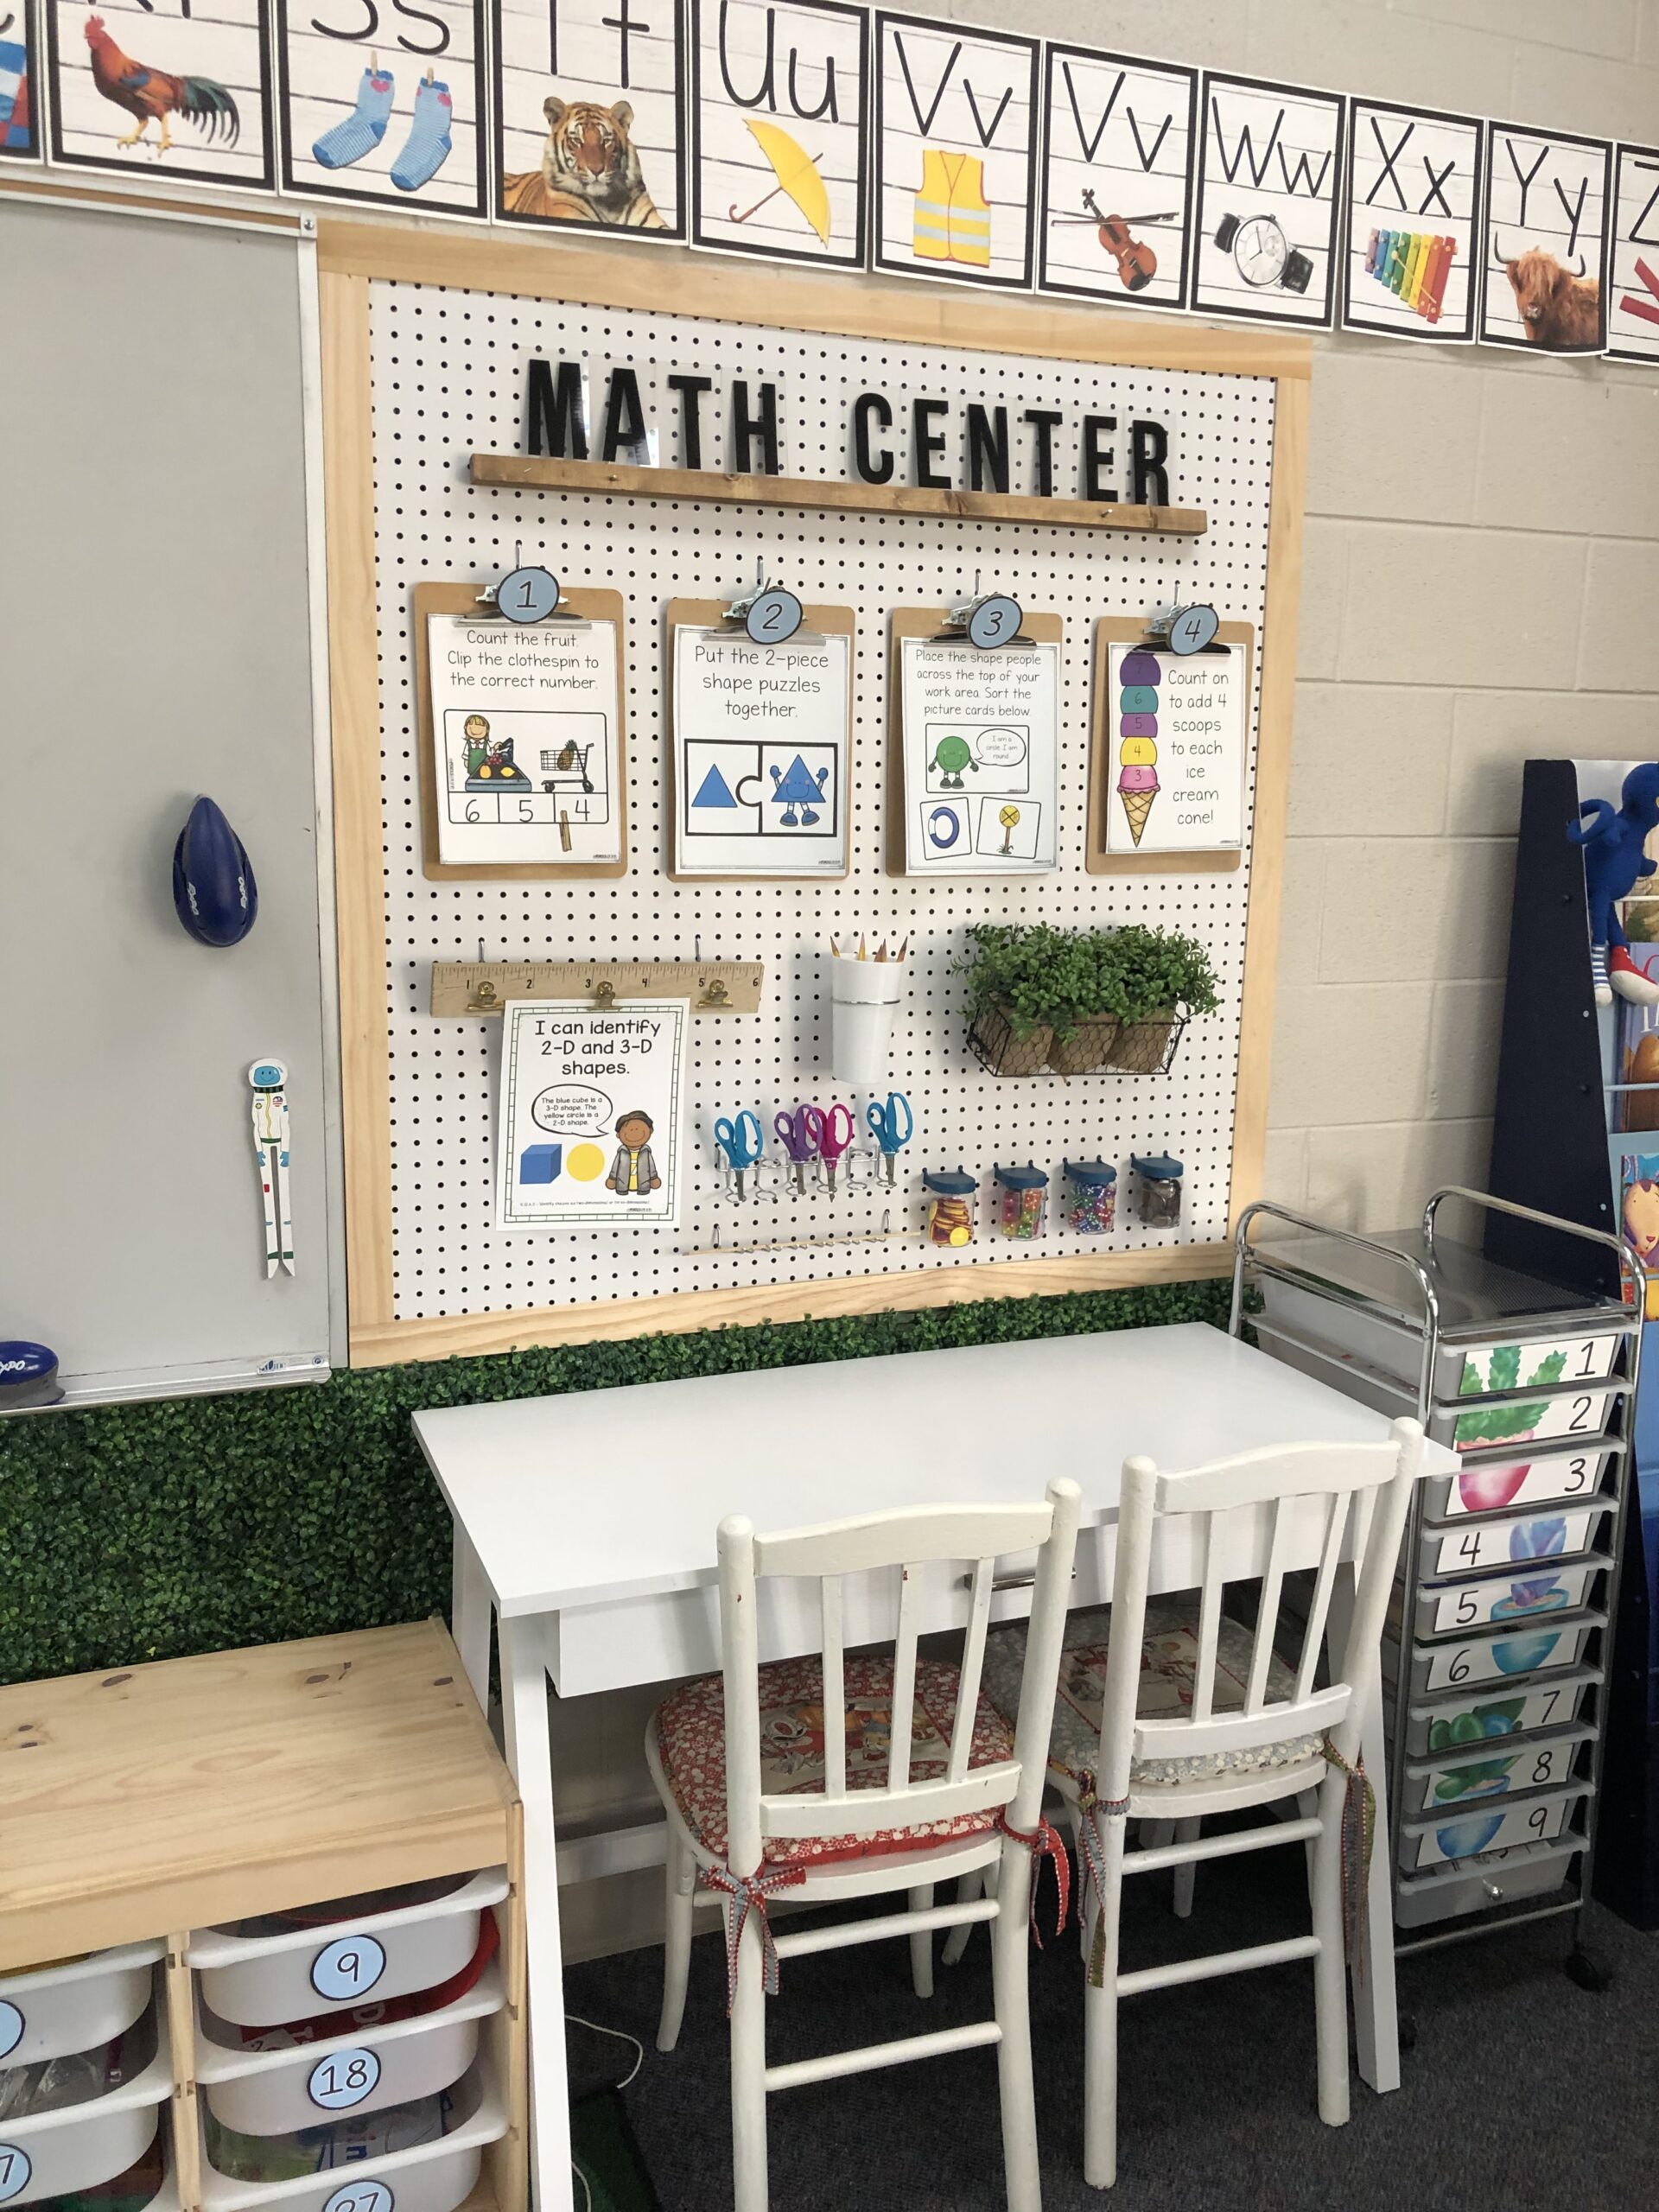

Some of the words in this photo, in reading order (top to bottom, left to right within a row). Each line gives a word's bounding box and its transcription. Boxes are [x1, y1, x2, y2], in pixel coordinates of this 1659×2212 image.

[719, 0, 838, 124] Uu
[893, 29, 1014, 149] Vv
[1063, 60, 1173, 173] Vv
[1211, 96, 1332, 199] Ww
[1364, 115, 1457, 219] Xx
[1505, 137, 1589, 257] Yy
[527, 359, 780, 476] MATH
[854, 391, 1172, 507] CENTER
[516, 581, 538, 608] 1
[762, 603, 783, 630] 2
[982, 610, 1003, 636] 3
[467, 629, 508, 645] Count
[514, 632, 538, 645] the
[1185, 619, 1201, 643] 4
[448, 650, 472, 668] Clip
[478, 652, 502, 665] the
[508, 653, 580, 671] clothespin
[585, 655, 599, 669] to
[696, 645, 724, 663] Put
[731, 648, 759, 664] the
[766, 649, 829, 671] 2-piece
[916, 649, 944, 662] Place
[948, 651, 967, 663] the
[970, 652, 1002, 666] shape
[1007, 653, 1041, 667] people
[450, 672, 475, 686] the
[480, 674, 535, 688] correct
[702, 672, 753, 694] shape
[760, 676, 821, 695] puzzles
[917, 670, 951, 680] across
[956, 669, 975, 680] the
[979, 670, 995, 683] top
[1000, 670, 1012, 681] of
[1016, 673, 1040, 684] your
[1168, 670, 1207, 684] Count
[1212, 674, 1229, 684] on
[925, 686, 950, 697] work
[985, 686, 1008, 699] Sort
[1013, 688, 1032, 699] the
[1135, 692, 1142, 705] 6
[1169, 694, 1182, 709] to
[1187, 694, 1212, 709] add
[1217, 693, 1227, 708] 4
[725, 699, 798, 721] together.
[925, 703, 961, 716] picture
[965, 704, 995, 715] cards
[1135, 717, 1142, 729] 5
[1173, 721, 1222, 735] scoops
[1134, 745, 1141, 758] 4
[1171, 741, 1185, 755] to
[1189, 740, 1223, 755] each
[1135, 769, 1142, 782] 3
[1185, 765, 1205, 779] ice
[1173, 790, 1219, 802] cream
[466, 799, 480, 823] 6
[519, 799, 534, 823] 5
[575, 799, 590, 822] 4
[1177, 809, 1213, 824] cone!
[465, 979, 470, 989] 1
[526, 979, 532, 989] 2
[585, 978, 591, 988] 3
[642, 977, 648, 988] 4
[698, 977, 705, 987] 5
[753, 976, 759, 987] 6
[535, 1020, 546, 1035] I
[551, 1023, 583, 1035] can
[590, 1019, 661, 1037] identify
[541, 1040, 575, 1055] 2-D
[582, 1039, 614, 1055] and
[620, 1039, 652, 1054] 3-D
[562, 1060, 630, 1078] shapes.
[0, 1360, 26, 1375] XPO
[1574, 1341, 1596, 1376] 1
[1568, 1395, 1592, 1431] 2
[1564, 1458, 1586, 1492] 3
[1459, 1531, 1481, 1566] 4
[1456, 1590, 1480, 1624] 5
[1448, 1649, 1471, 1682] 6
[1542, 1690, 1560, 1724] 7
[1532, 1751, 1553, 1783] 8
[1529, 1807, 1548, 1838] 9
[337, 1952, 360, 1984] 9
[318, 2058, 369, 2098] 18
